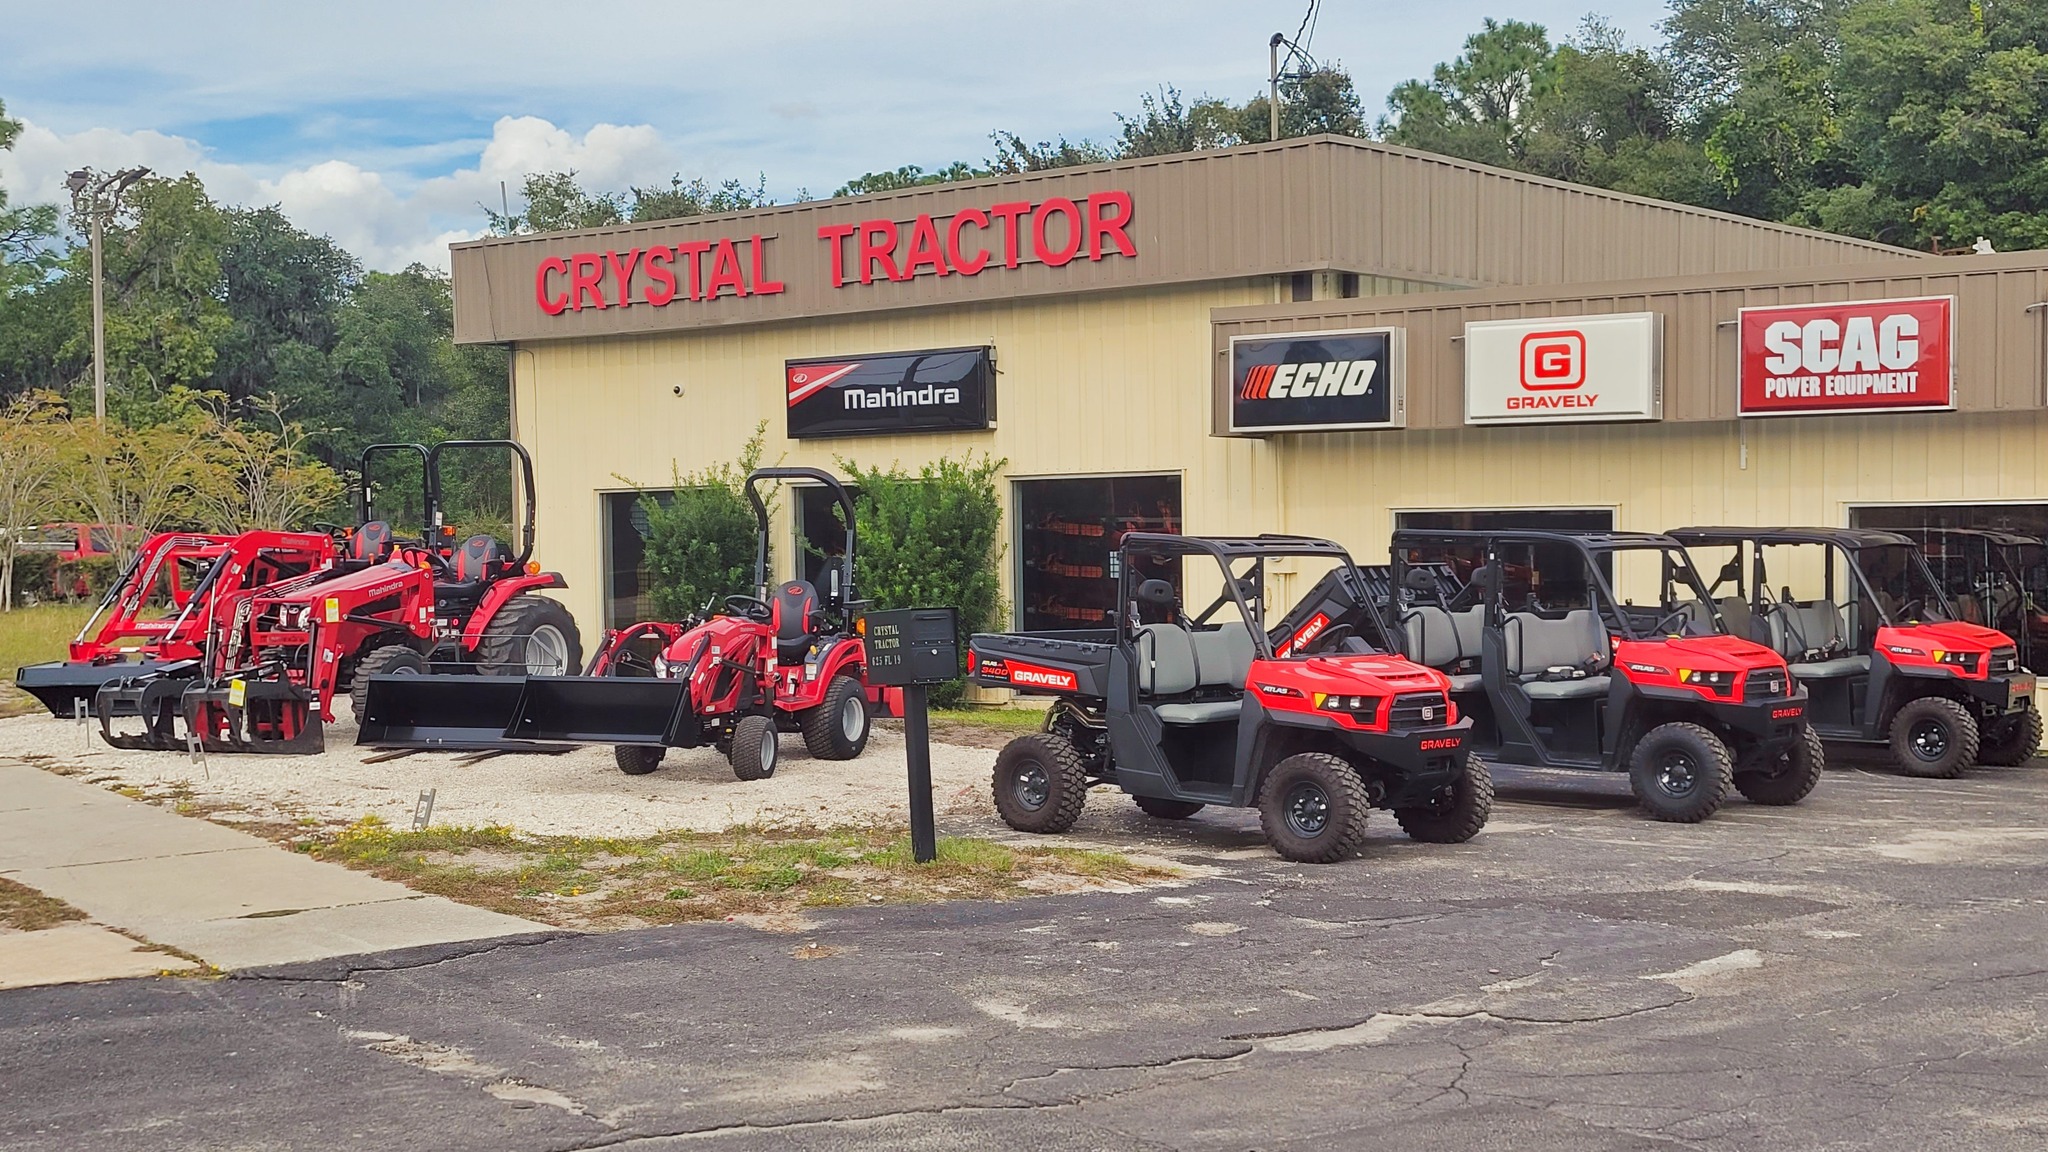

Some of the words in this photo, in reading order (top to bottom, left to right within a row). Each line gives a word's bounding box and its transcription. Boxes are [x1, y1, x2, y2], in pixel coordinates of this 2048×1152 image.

[535, 233, 784, 315] CRYSTAL
[817, 189, 1136, 288] TRACTOR
[1765, 313, 1919, 375] SCAG
[1765, 376, 1821, 398] POWER
[1825, 371, 1919, 396] EQUIPMENT
[844, 385, 960, 410] Mahindra
[1507, 394, 1599, 409] GRAVELY
[368, 581, 404, 597] Mahindra
[873, 625, 900, 636] CRYSTAL
[874, 638, 900, 650] TRACTOR
[884, 655, 893, 666] FL
[1014, 670, 1071, 686] GRAVELY
[1262, 685, 1288, 694] ATLAS
[1772, 707, 1803, 719] GRAVELY
[1420, 737, 1461, 750] GRAVELY
